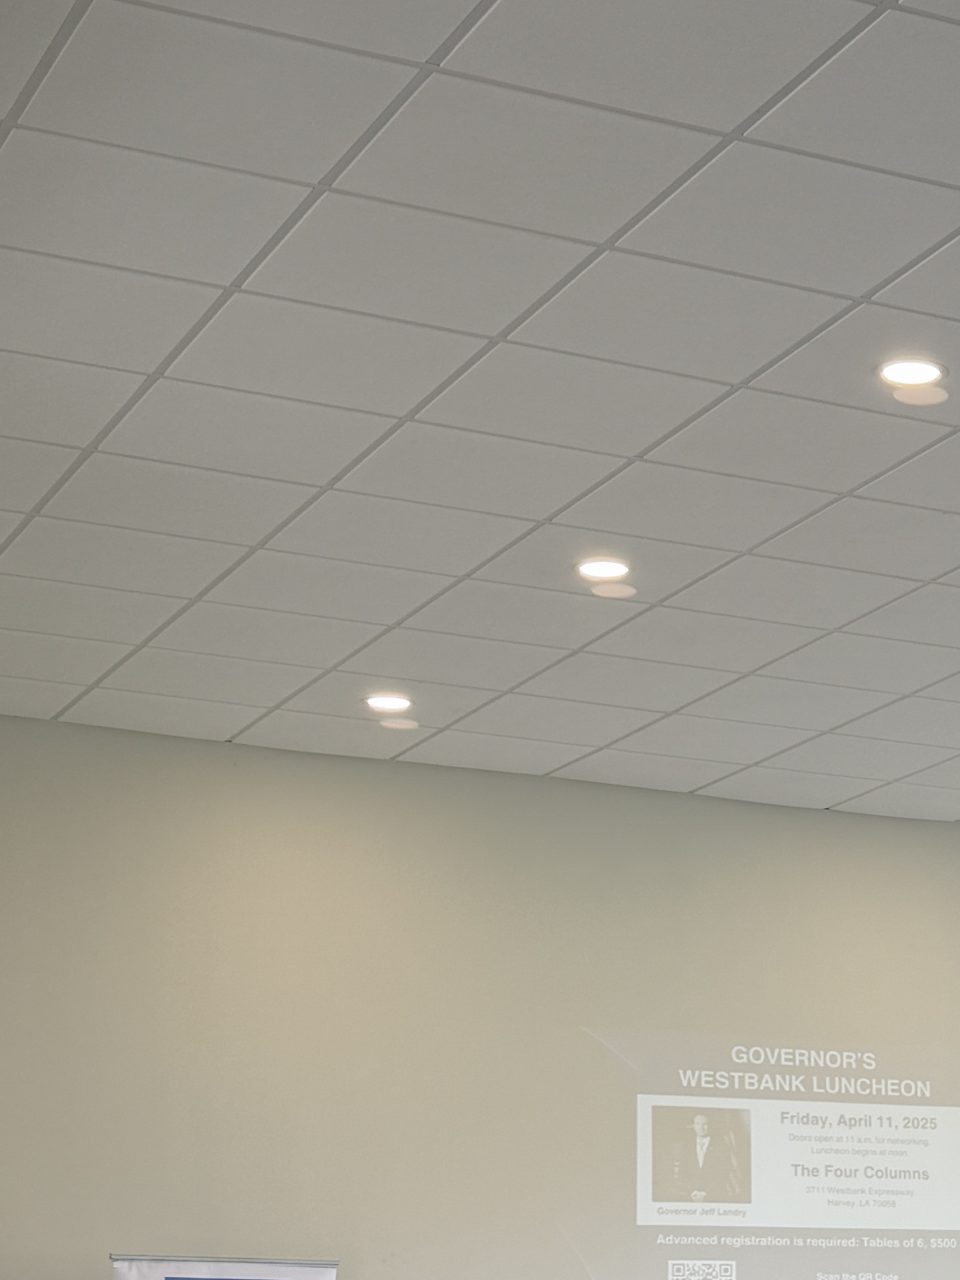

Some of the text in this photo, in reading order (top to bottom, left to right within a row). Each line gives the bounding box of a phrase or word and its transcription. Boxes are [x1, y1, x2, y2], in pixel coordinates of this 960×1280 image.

[731, 1046, 876, 1070] GOVERNOR'S
[679, 1069, 931, 1097] WESTBANK LUNCHEON
[780, 1111, 938, 1130] Friday, April 11, 2025
[811, 1147, 850, 1155] Luncheon
[791, 1163, 930, 1180] The Four Columns
[657, 1206, 747, 1218] Governor Jeff Landry
[656, 1233, 718, 1246] Advanced
[720, 1235, 791, 1249] registration
[793, 1236, 804, 1247] is
[806, 1235, 860, 1250] required:
[862, 1236, 901, 1248] Tables
[903, 1237, 915, 1248] of
[930, 1238, 957, 1249] $500
